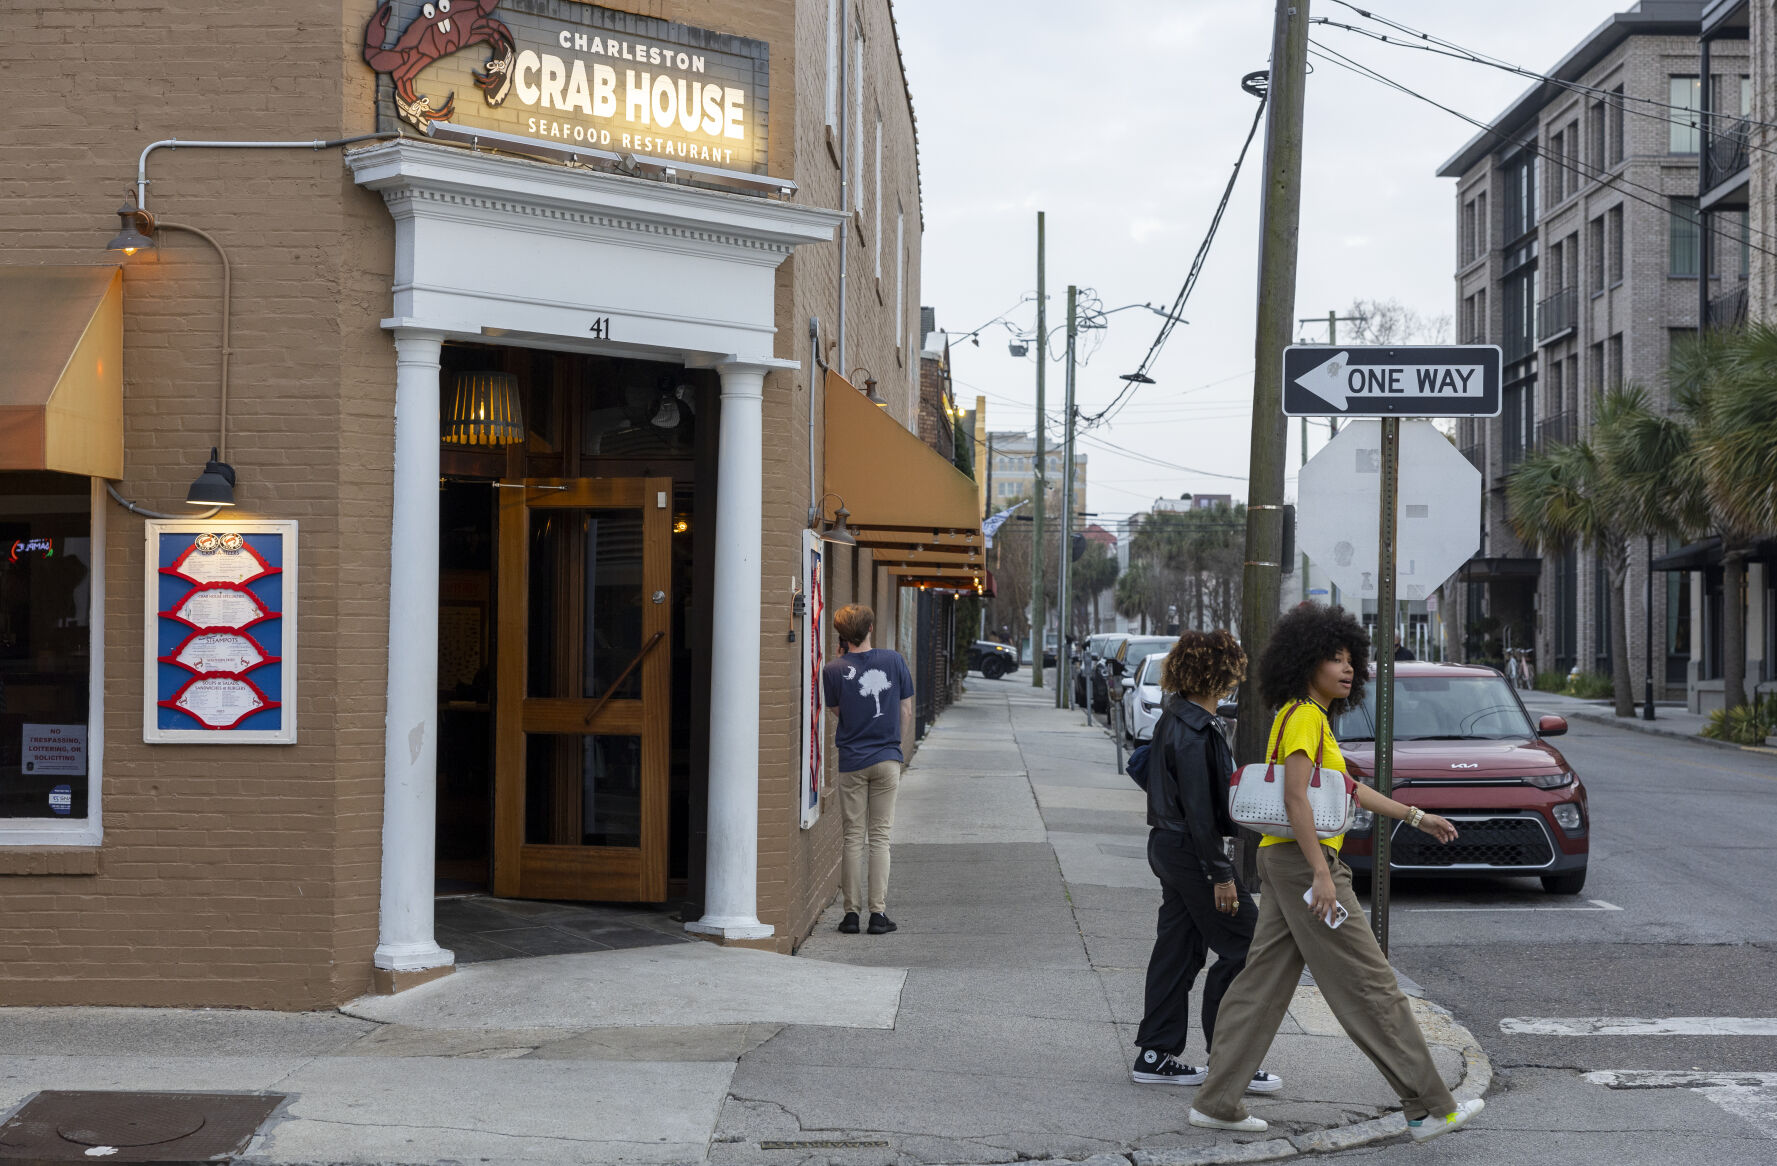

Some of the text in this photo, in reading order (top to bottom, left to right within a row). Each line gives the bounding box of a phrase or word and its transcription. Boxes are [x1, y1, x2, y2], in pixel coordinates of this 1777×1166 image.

[559, 30, 705, 73] CHARLESTON
[515, 49, 745, 140] CRAB HOUSE
[528, 117, 733, 164] SEAFOOD RESTAURANT
[589, 316, 611, 340] 41
[1348, 368, 1475, 393] ONE WAY
